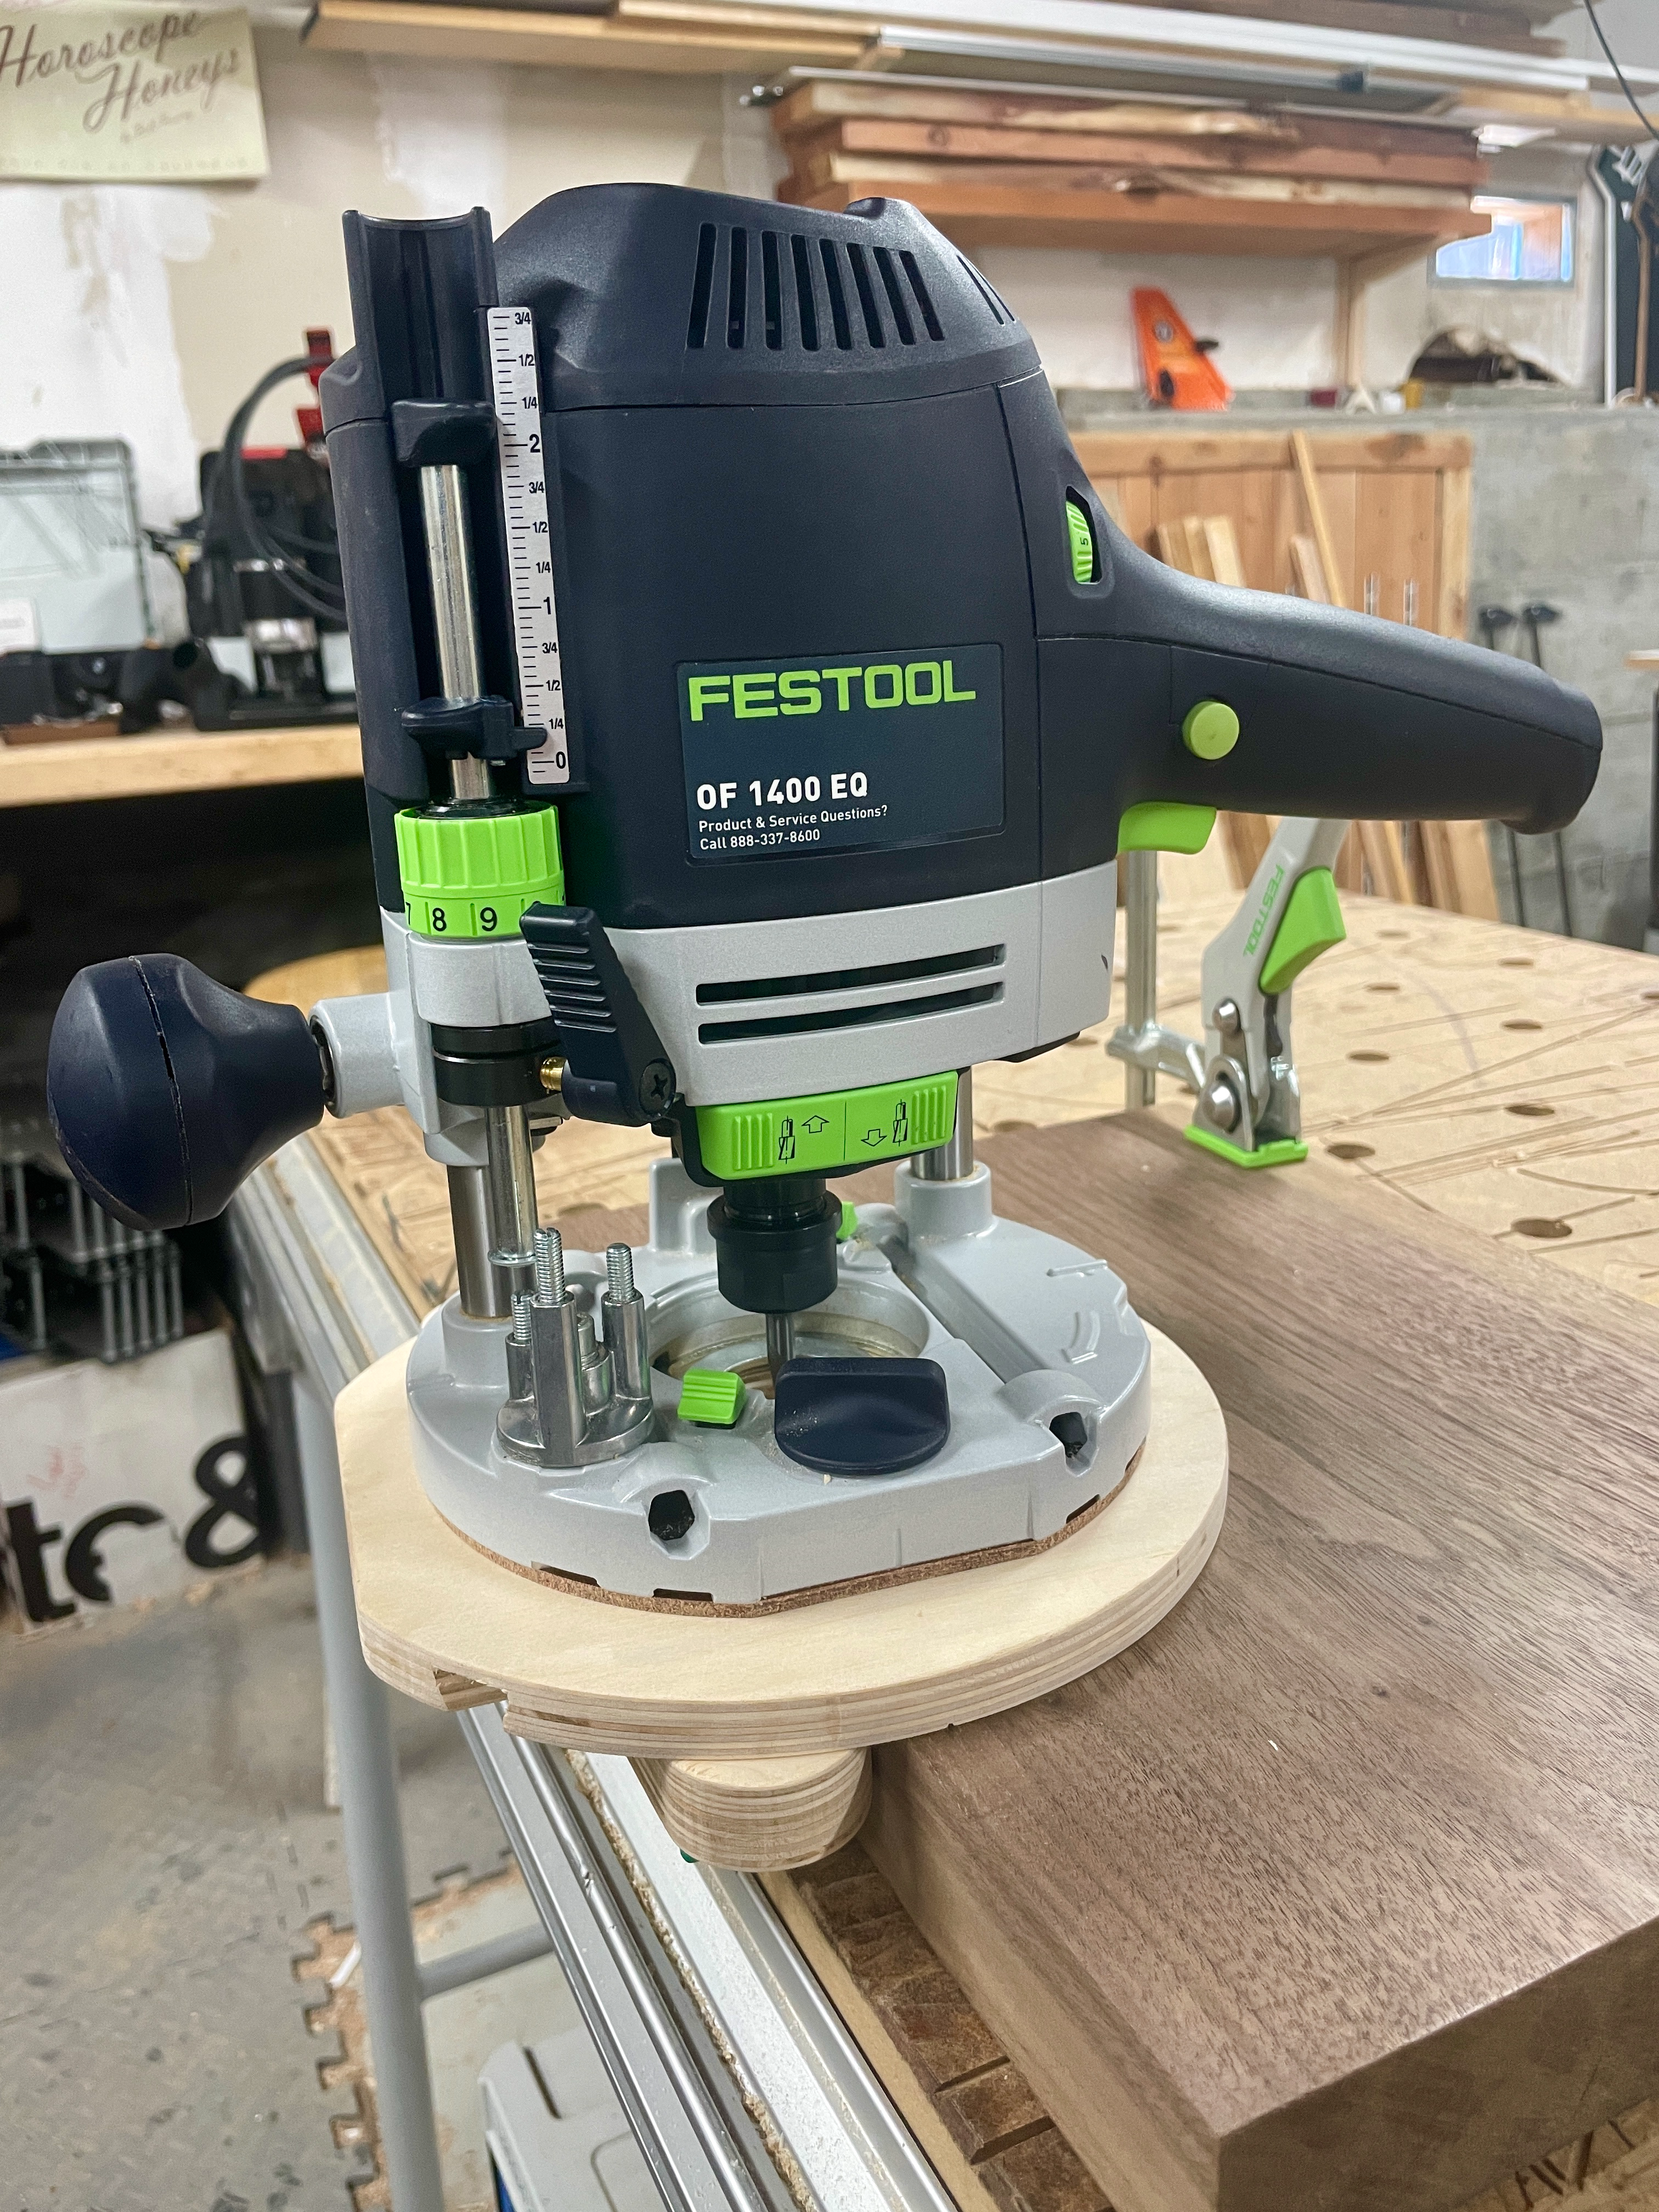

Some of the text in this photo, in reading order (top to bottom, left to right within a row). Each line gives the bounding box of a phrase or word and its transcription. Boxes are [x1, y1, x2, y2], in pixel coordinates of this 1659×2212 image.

[0, 12, 202, 88] Horoscope
[75, 48, 239, 133] Honeys
[515, 312, 532, 324] 3/4
[518, 354, 535, 366] 1/2
[522, 396, 538, 409] 1/4
[529, 434, 540, 453] 2
[529, 482, 544, 494] 3/4
[532, 521, 548, 533] 1/2
[1080, 537, 1088, 546] 5
[535, 562, 551, 574] 1/4
[543, 596, 551, 615] 1
[541, 642, 558, 654] 3/4
[545, 680, 561, 691] 1/2
[689, 660, 976, 721] FESTOOL
[549, 718, 564, 730] 1/4
[556, 751, 566, 769] 0
[696, 771, 868, 810] OF 1400 EQ
[698, 805, 888, 833] Product & Service Questions?
[699, 829, 821, 850] Call 888-337-8600
[432, 907, 447, 932] 8
[480, 907, 498, 932] 9
[1243, 864, 1285, 957] FESTOOL
